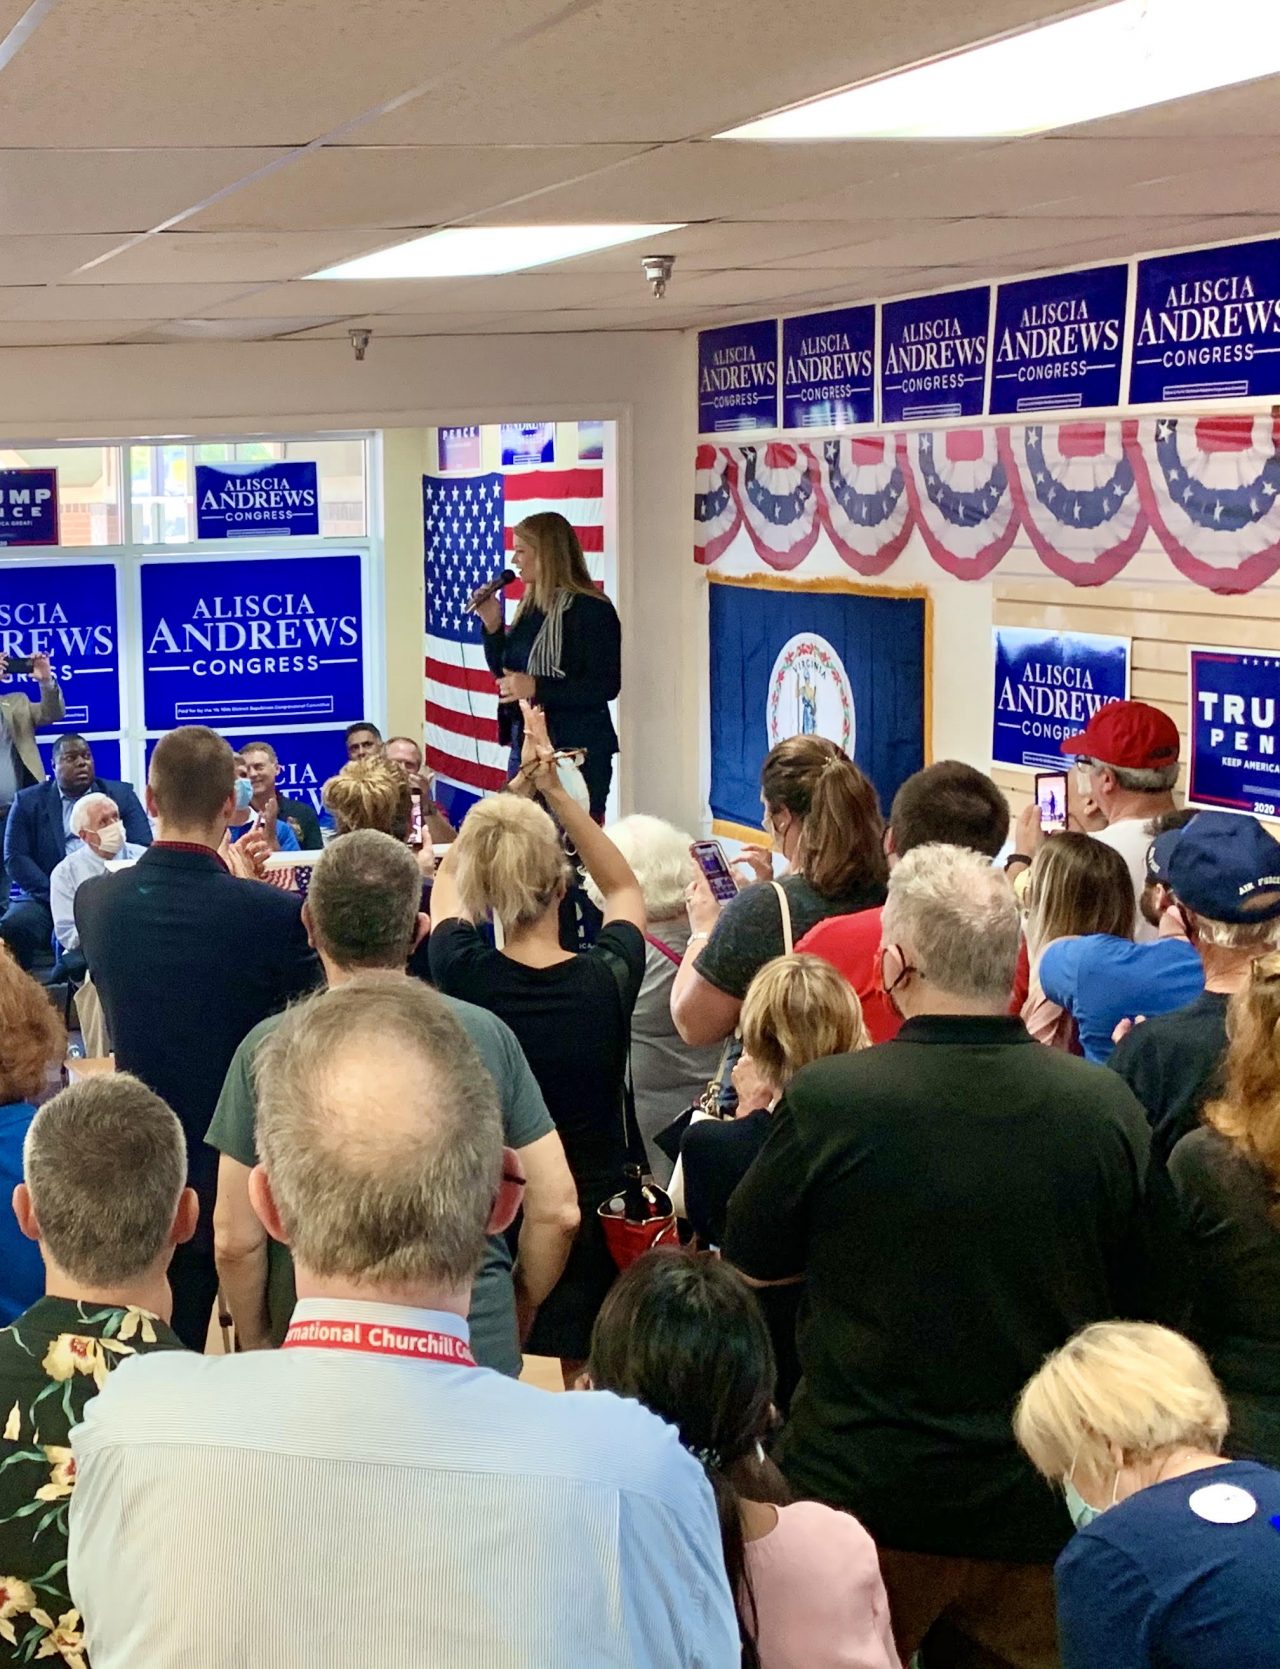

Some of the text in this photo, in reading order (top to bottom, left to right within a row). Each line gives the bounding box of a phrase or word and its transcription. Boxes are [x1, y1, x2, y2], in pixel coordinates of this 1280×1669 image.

[1165, 275, 1255, 308] ALISCIA
[1020, 299, 1088, 328] ALISCIA
[902, 317, 962, 344] ALISCIA
[996, 319, 1119, 362] ANDREWS
[713, 346, 756, 365] ALISCIA
[800, 333, 850, 356] ALISCIA
[884, 336, 985, 375] ANDREWS
[1163, 343, 1254, 368] CONGRESS
[700, 361, 775, 392] ANDREWS
[785, 350, 872, 385] ANDREWS
[1018, 360, 1087, 382] CONGRESS
[801, 384, 851, 401] CONGRESS
[902, 373, 964, 393] CONGRESS
[713, 392, 758, 408] CONGRESS
[224, 478, 290, 491] ALISCIA
[201, 489, 315, 510] ANDREWS
[225, 510, 293, 521] CONGRESS
[192, 593, 315, 619] ALISCIA
[146, 616, 359, 654] ANDREWS
[192, 655, 319, 676] CONGRESS
[1022, 662, 1094, 690] ALISCIA
[1222, 756, 1280, 773] KEEP AMERICA
[1253, 802, 1275, 815] 2020
[368, 1328, 453, 1356] Churchill
